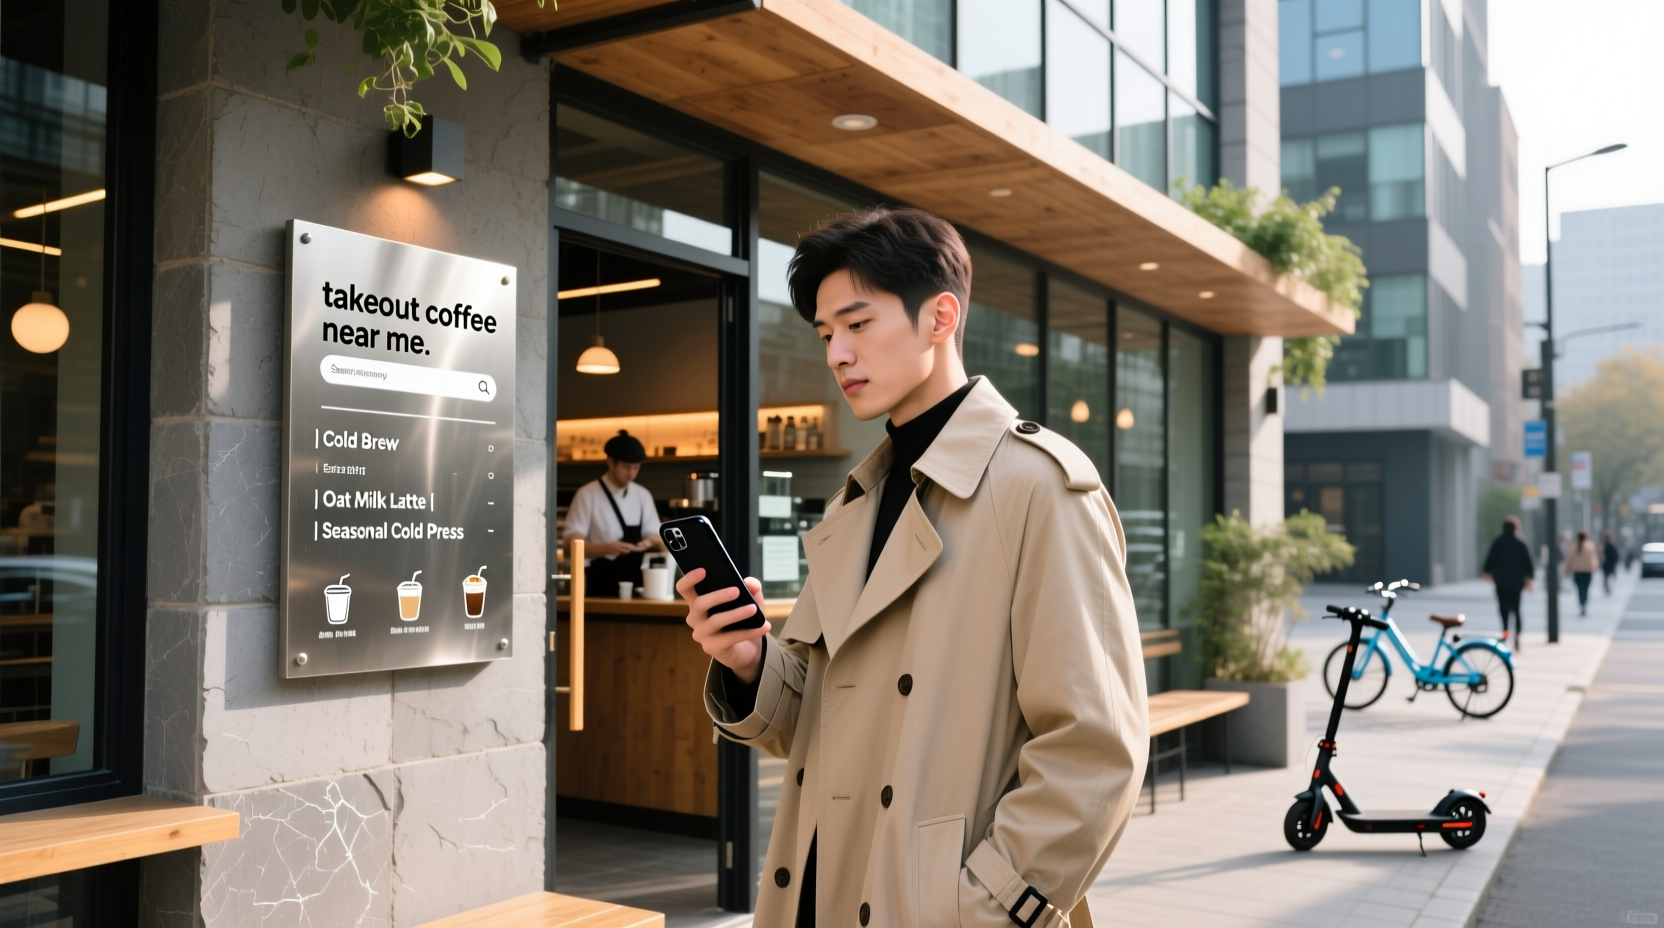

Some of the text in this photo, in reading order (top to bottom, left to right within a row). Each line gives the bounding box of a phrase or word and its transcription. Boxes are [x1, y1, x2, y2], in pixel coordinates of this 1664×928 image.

[322, 281, 497, 334] takeout coffee
[322, 321, 430, 356] near me.
[323, 430, 400, 451] Cold Brew
[322, 490, 427, 510] Oat Milk Latte
[322, 521, 465, 540] Seasonal Cold Press
